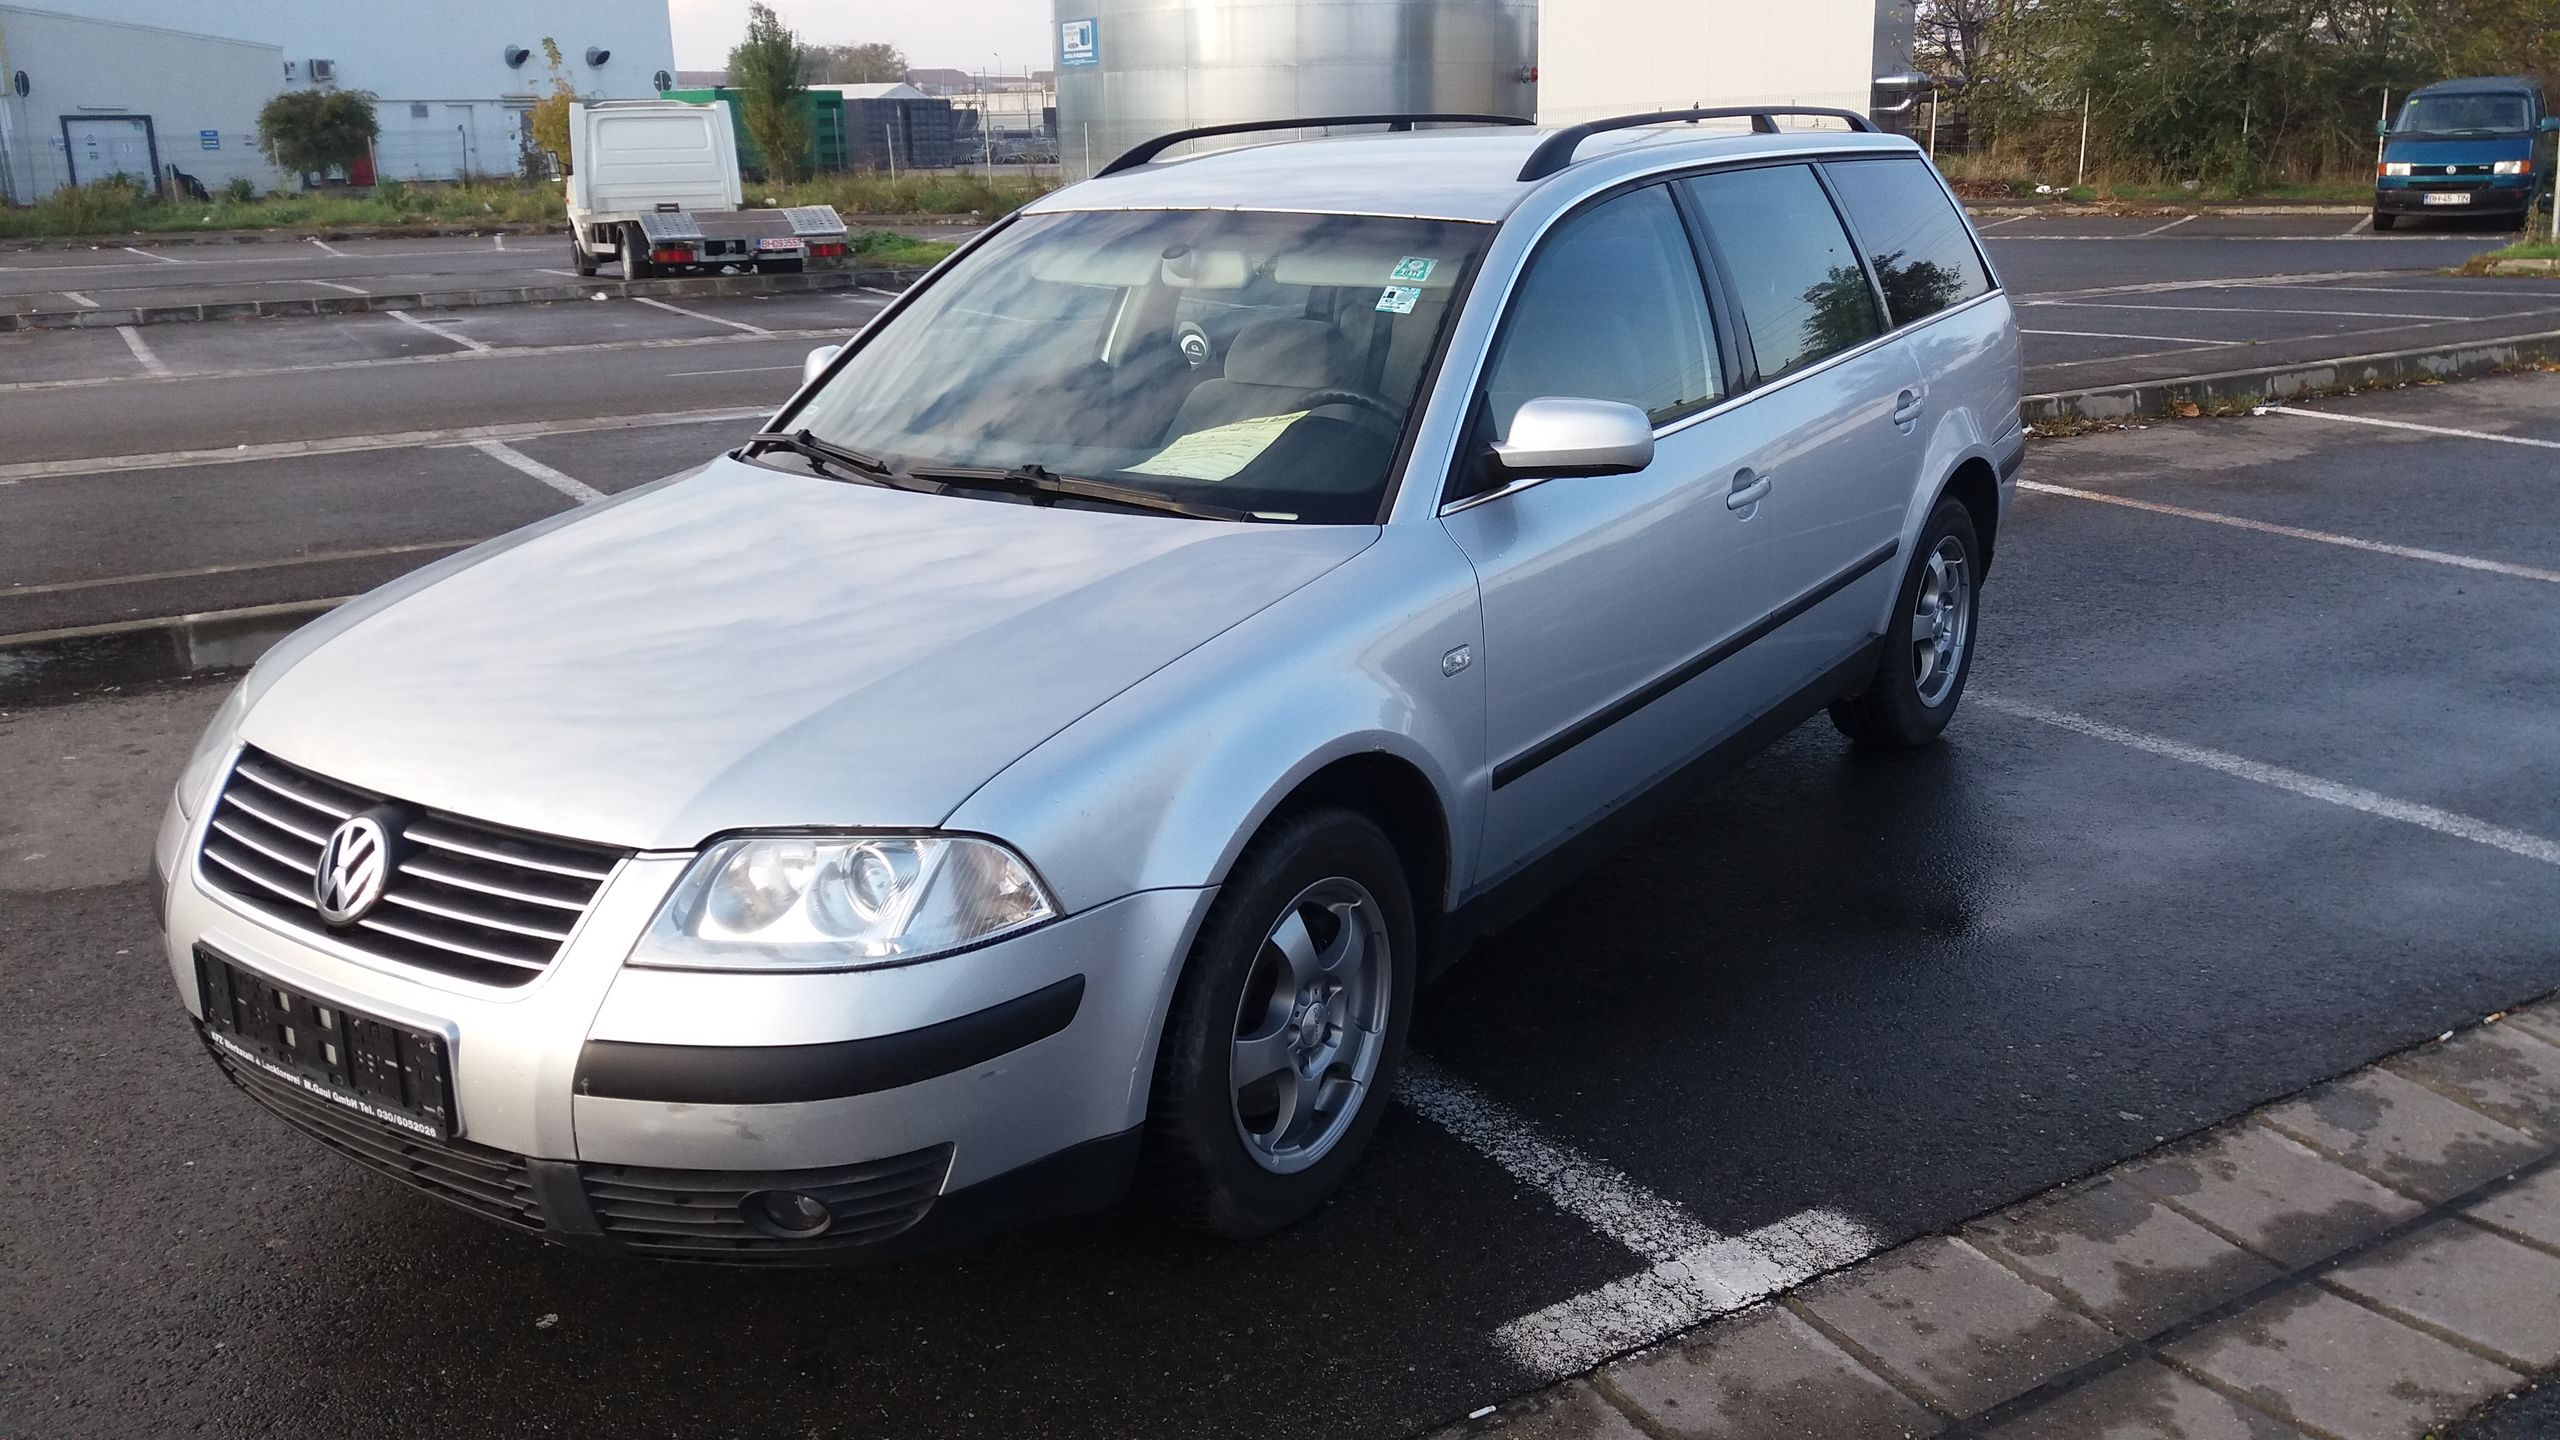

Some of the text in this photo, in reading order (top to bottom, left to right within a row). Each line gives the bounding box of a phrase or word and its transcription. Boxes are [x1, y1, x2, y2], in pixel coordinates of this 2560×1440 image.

[318, 818, 385, 922] VW
[211, 1031, 225, 1046] KFZ
[223, 1038, 255, 1063] Werkstatt
[332, 1091, 358, 1110] GmbH
[359, 1101, 375, 1116] Tel.
